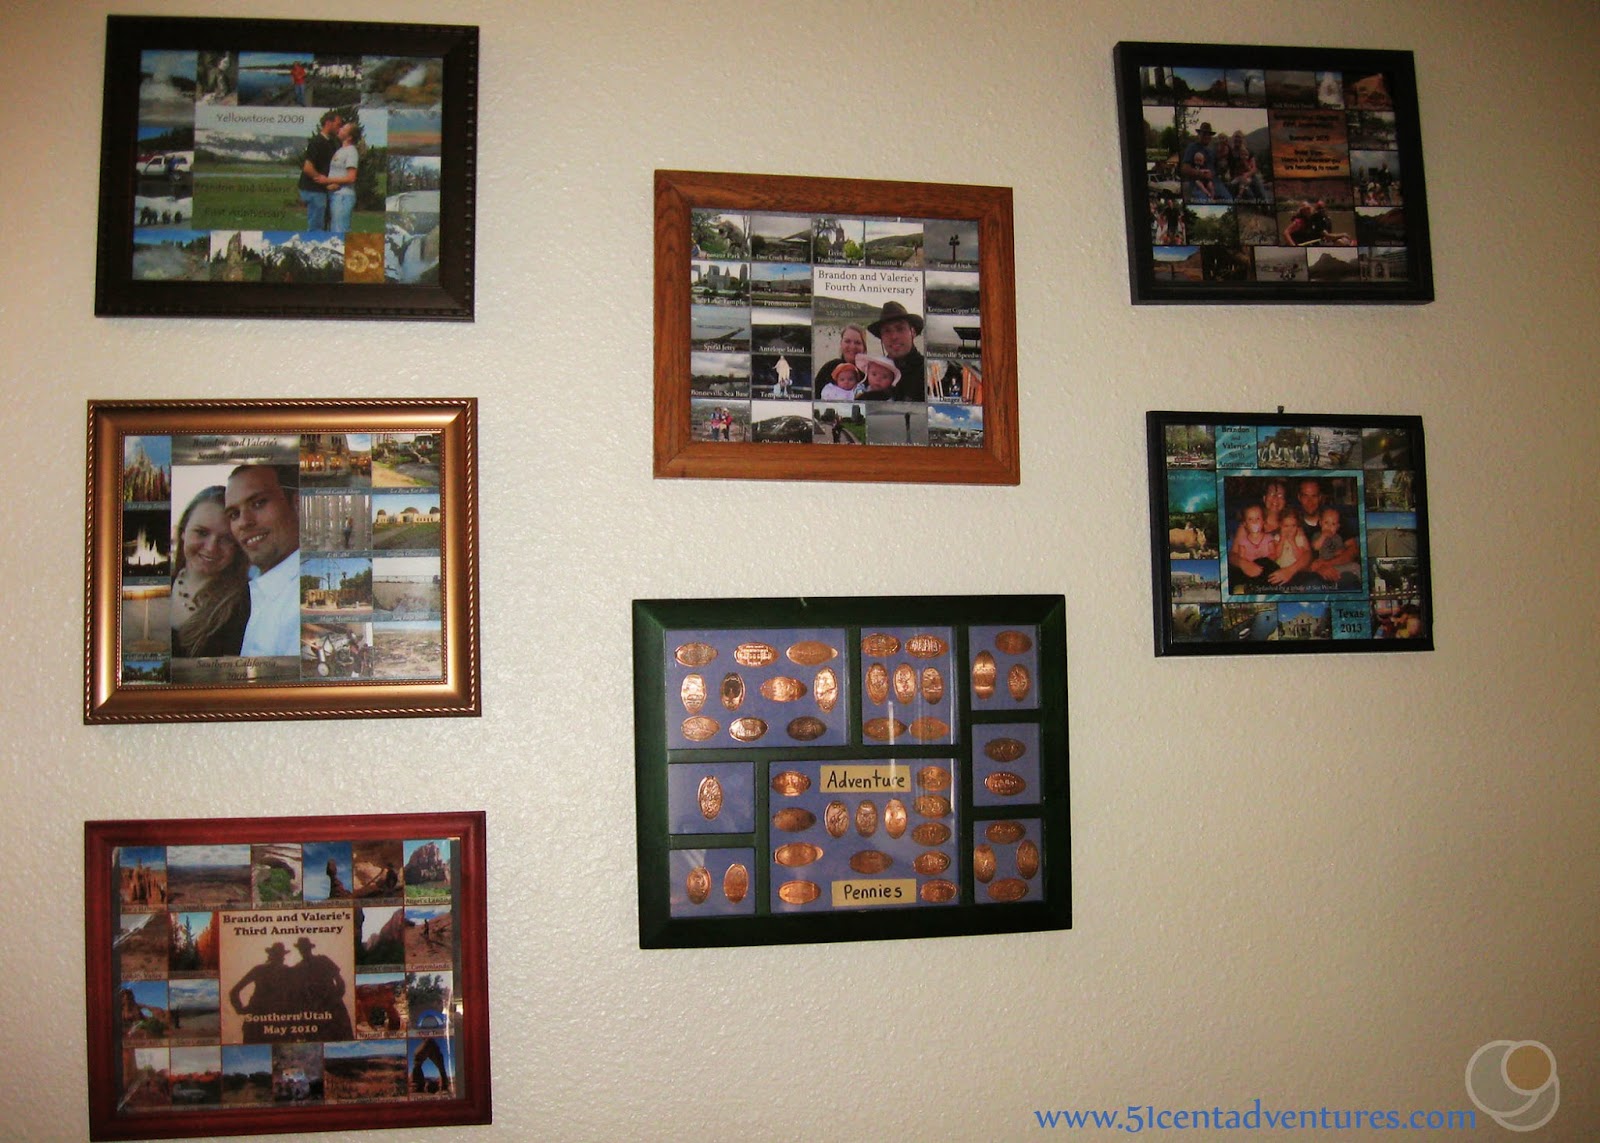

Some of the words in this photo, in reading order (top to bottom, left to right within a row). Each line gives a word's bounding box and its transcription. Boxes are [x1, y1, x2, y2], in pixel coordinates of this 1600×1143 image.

[217, 113, 275, 124] Yellowstone
[277, 115, 305, 125] 2008
[818, 270, 858, 281] Brandon
[860, 272, 878, 282] and
[880, 272, 920, 283] Valerie's
[825, 282, 857, 292] Fourth
[859, 283, 916, 296] Anniversary
[1336, 608, 1364, 618] Texas
[1340, 623, 1362, 633] 2013
[827, 769, 905, 788] Adventure
[844, 884, 903, 900] Pennies
[223, 914, 273, 924] Brandon
[277, 912, 298, 922] and
[301, 911, 351, 921] Valerie's
[233, 926, 268, 936] Third
[270, 925, 344, 935] Anniversary
[245, 1012, 300, 1022] Southern
[304, 1010, 333, 1020] Utah
[263, 1025, 287, 1036] May
[290, 1024, 318, 1034] 2010
